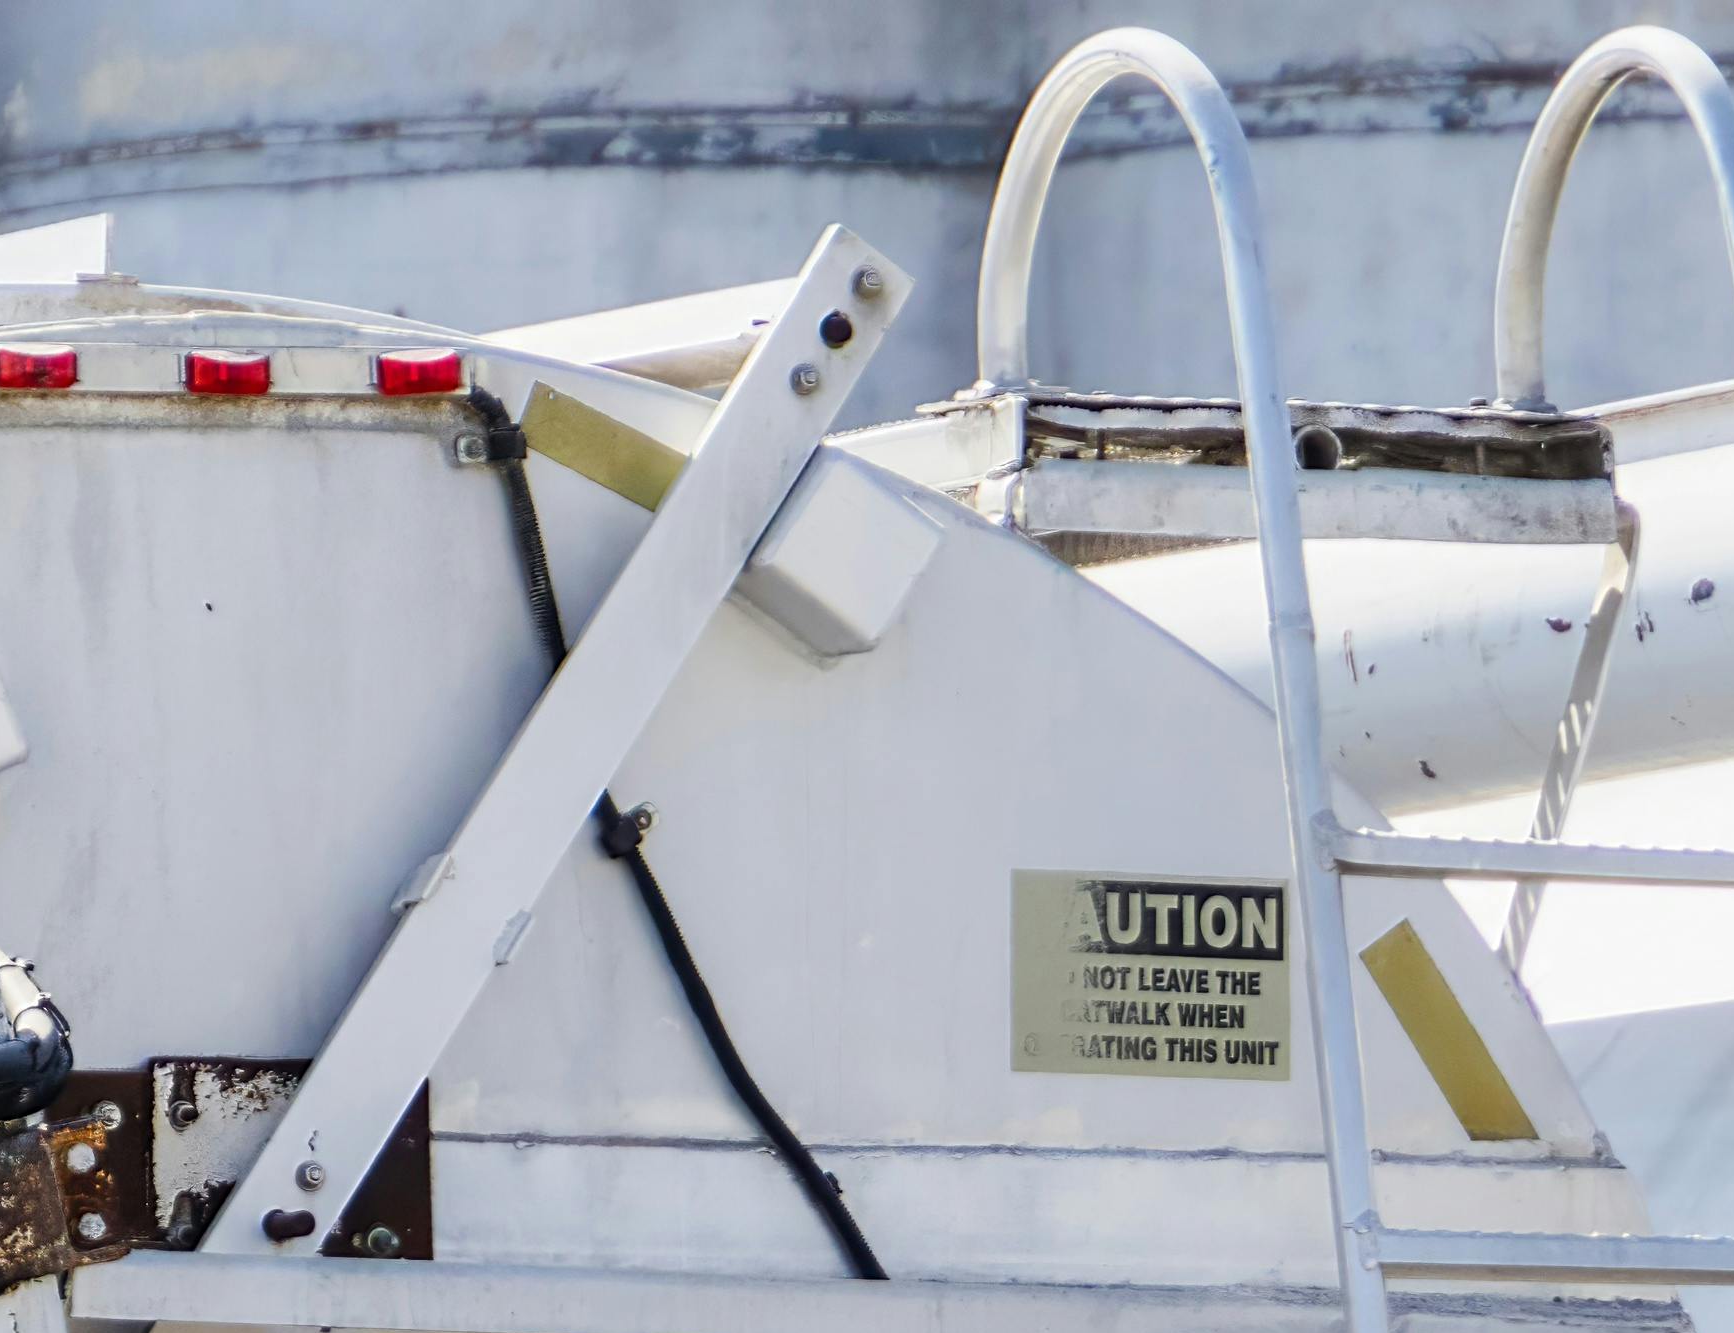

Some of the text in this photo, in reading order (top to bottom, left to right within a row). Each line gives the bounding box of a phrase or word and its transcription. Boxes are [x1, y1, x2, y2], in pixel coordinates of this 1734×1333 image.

[1082, 965, 1131, 991] NOT
[1138, 967, 1209, 994] LEAVE
[1216, 970, 1261, 996] THE
[1177, 1003, 1245, 1029] WHEN
[1165, 1037, 1217, 1064] THIS
[1224, 1040, 1279, 1066] UNIT
